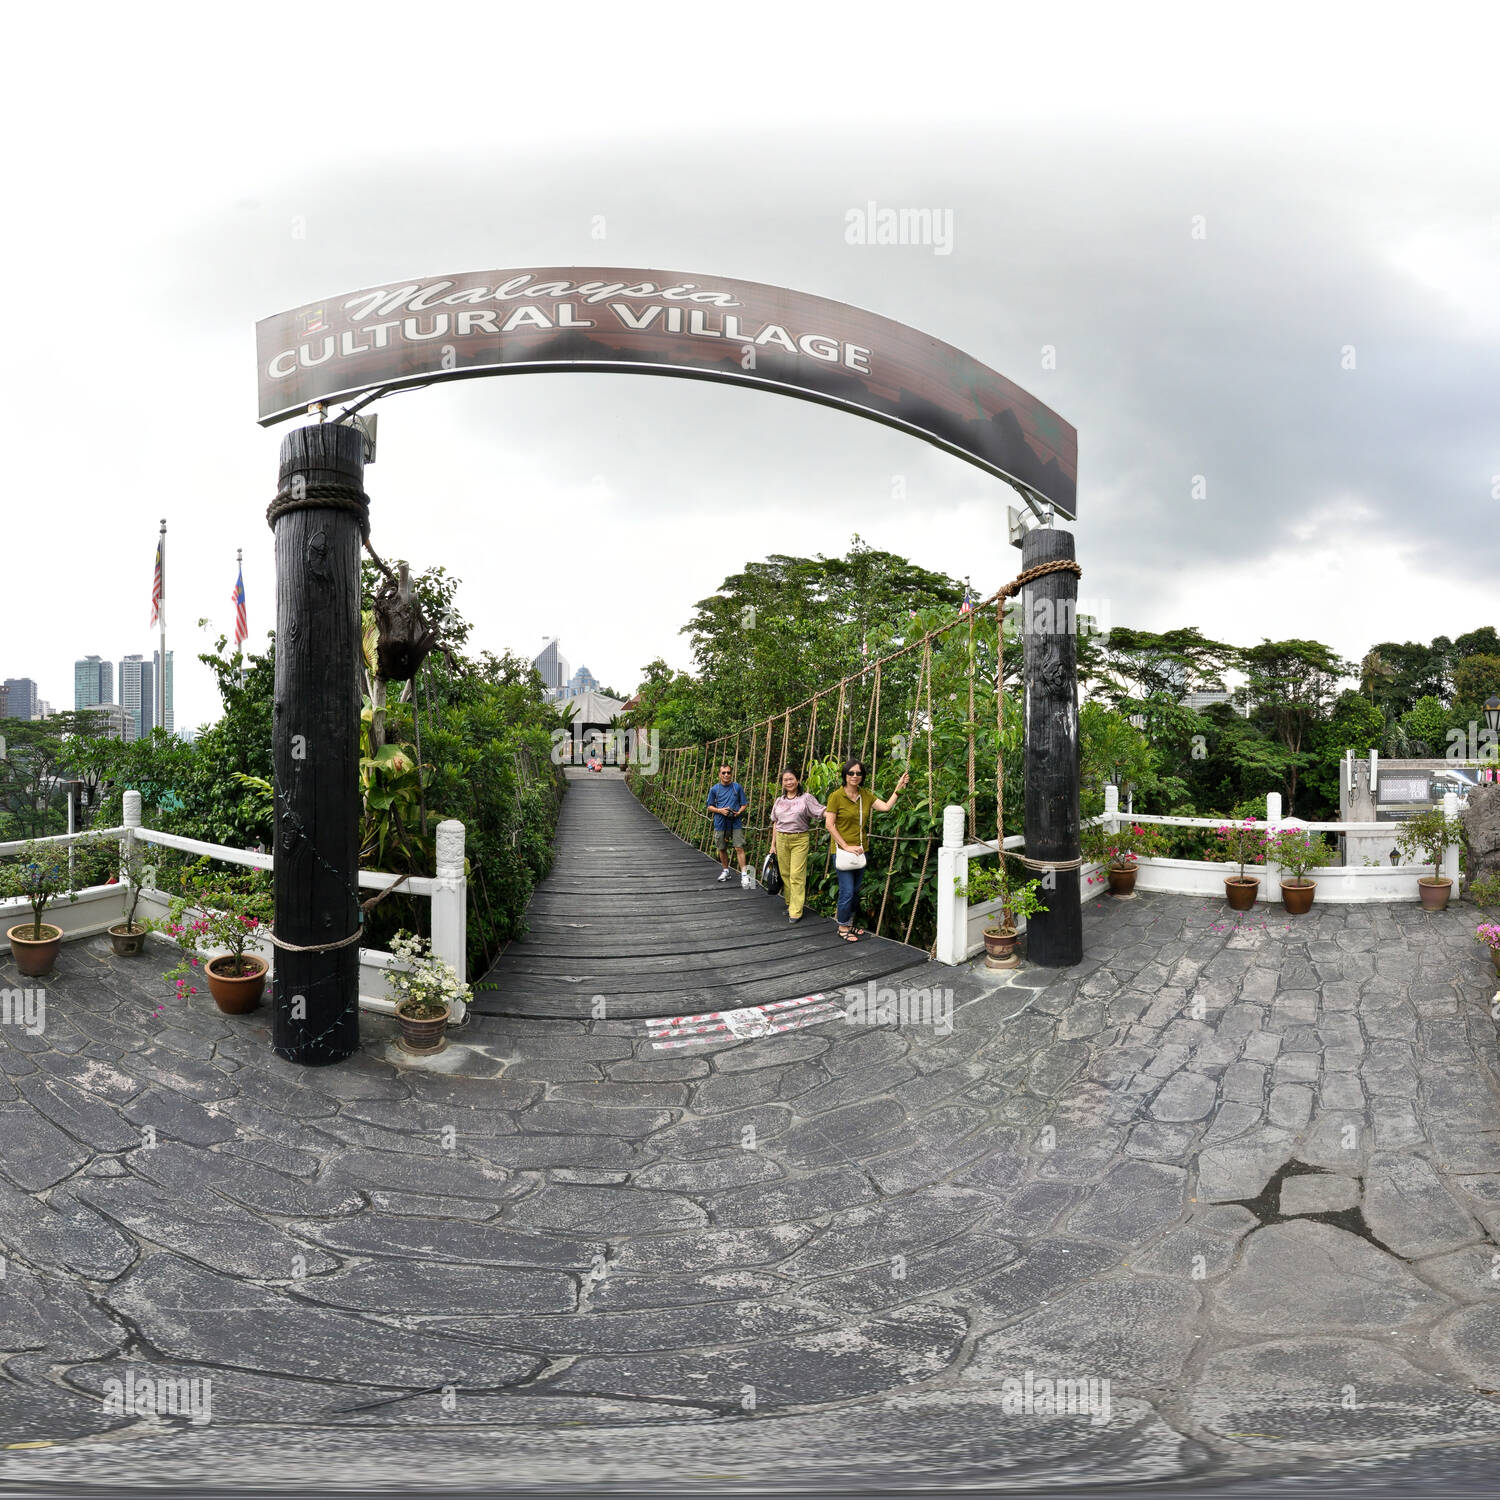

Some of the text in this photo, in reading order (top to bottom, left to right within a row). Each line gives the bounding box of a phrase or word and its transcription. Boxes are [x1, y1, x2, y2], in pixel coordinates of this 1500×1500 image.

[345, 274, 743, 321] Malaysia
[267, 303, 871, 379] CULTURAL VILLAGE
